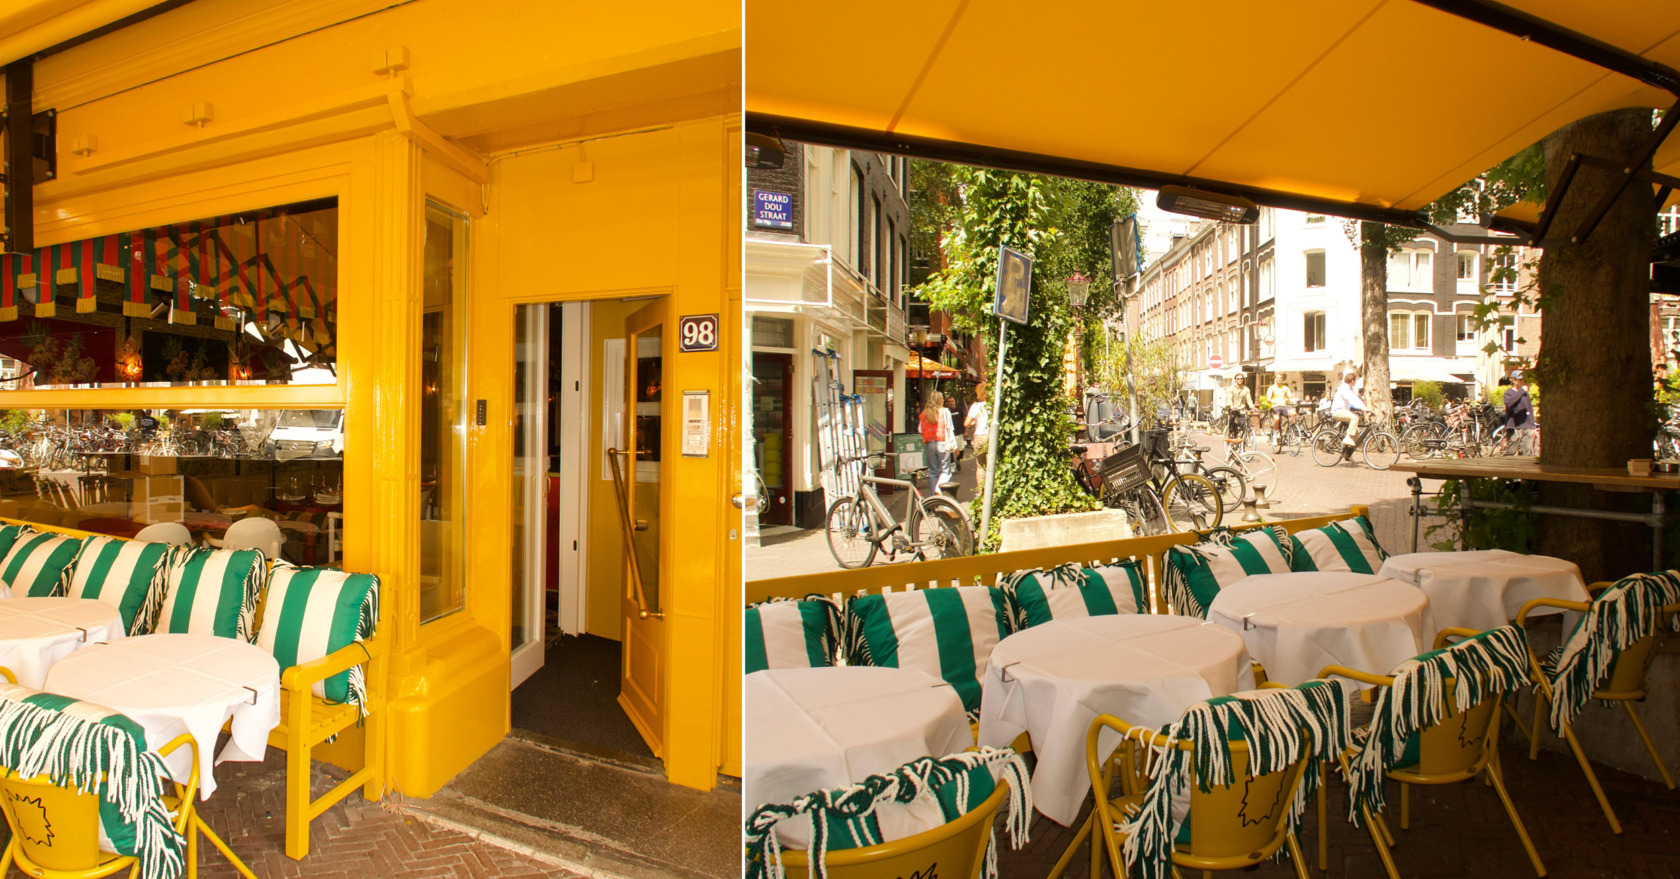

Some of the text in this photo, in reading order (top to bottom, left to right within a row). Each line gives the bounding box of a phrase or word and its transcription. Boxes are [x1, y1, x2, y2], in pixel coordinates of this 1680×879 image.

[758, 193, 789, 203] GERARD
[764, 202, 782, 211] DOU
[760, 210, 787, 220] STRAAT
[684, 321, 714, 345] 98
